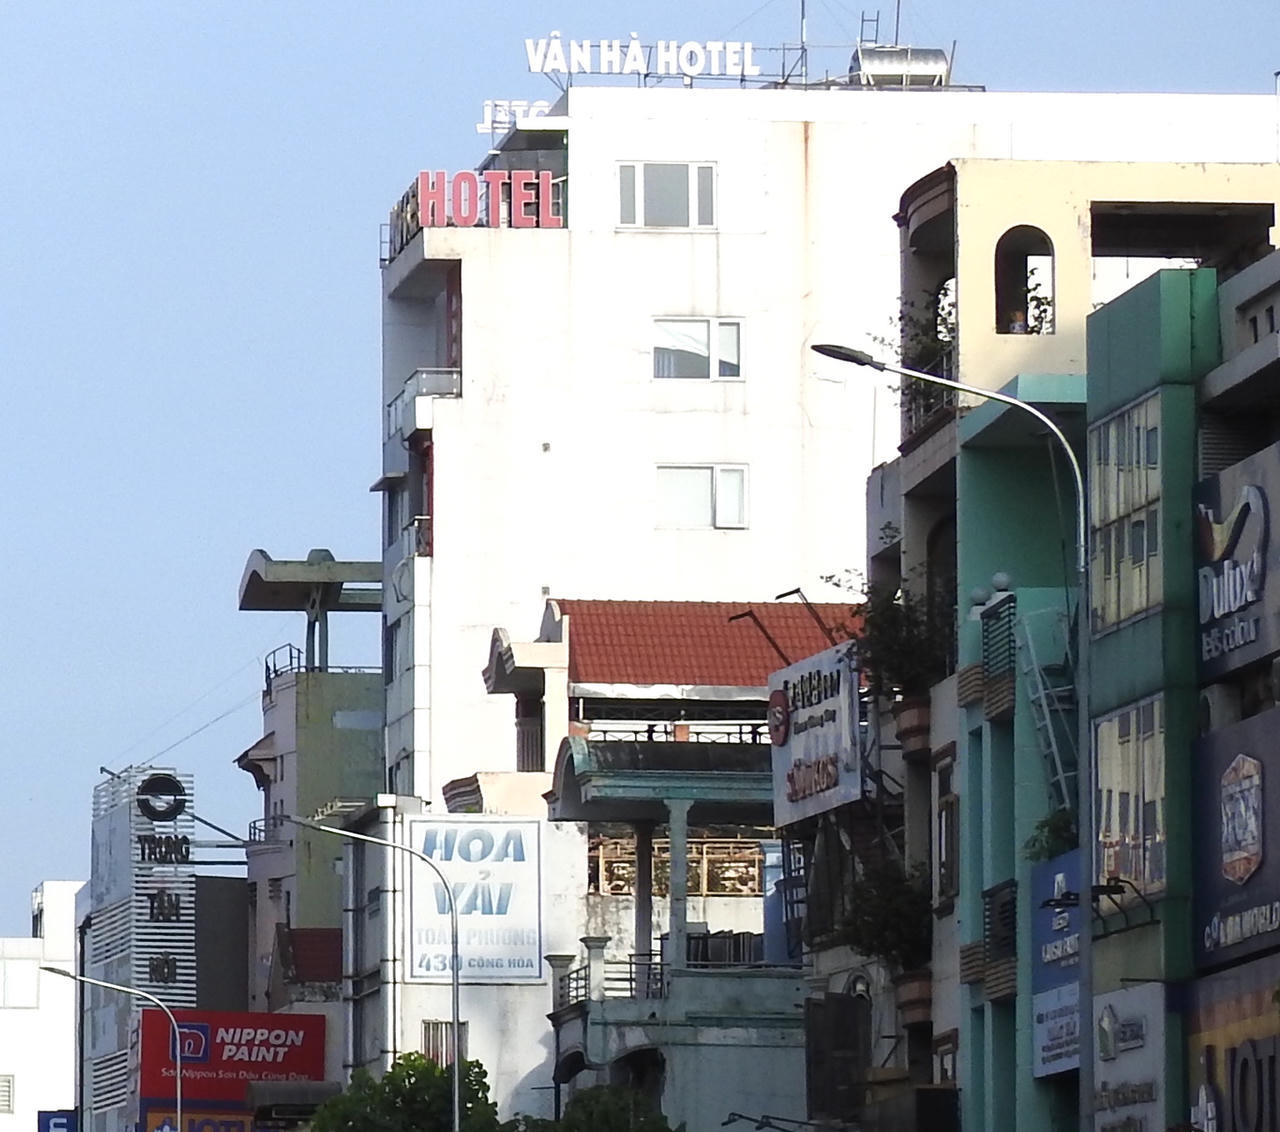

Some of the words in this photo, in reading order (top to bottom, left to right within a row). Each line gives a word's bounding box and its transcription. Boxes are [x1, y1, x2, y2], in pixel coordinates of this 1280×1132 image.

[525, 30, 591, 73] VÂN
[600, 32, 648, 73] HÀ
[656, 40, 760, 76] HOTEL
[418, 170, 563, 228] HOTEL
[1197, 560, 1256, 625] Dulux
[137, 834, 191, 865] TRUNG
[422, 828, 526, 862] HOA
[433, 870, 514, 915] VẢI
[215, 1027, 305, 1046] NIPPON
[221, 1045, 289, 1063] PAINT
